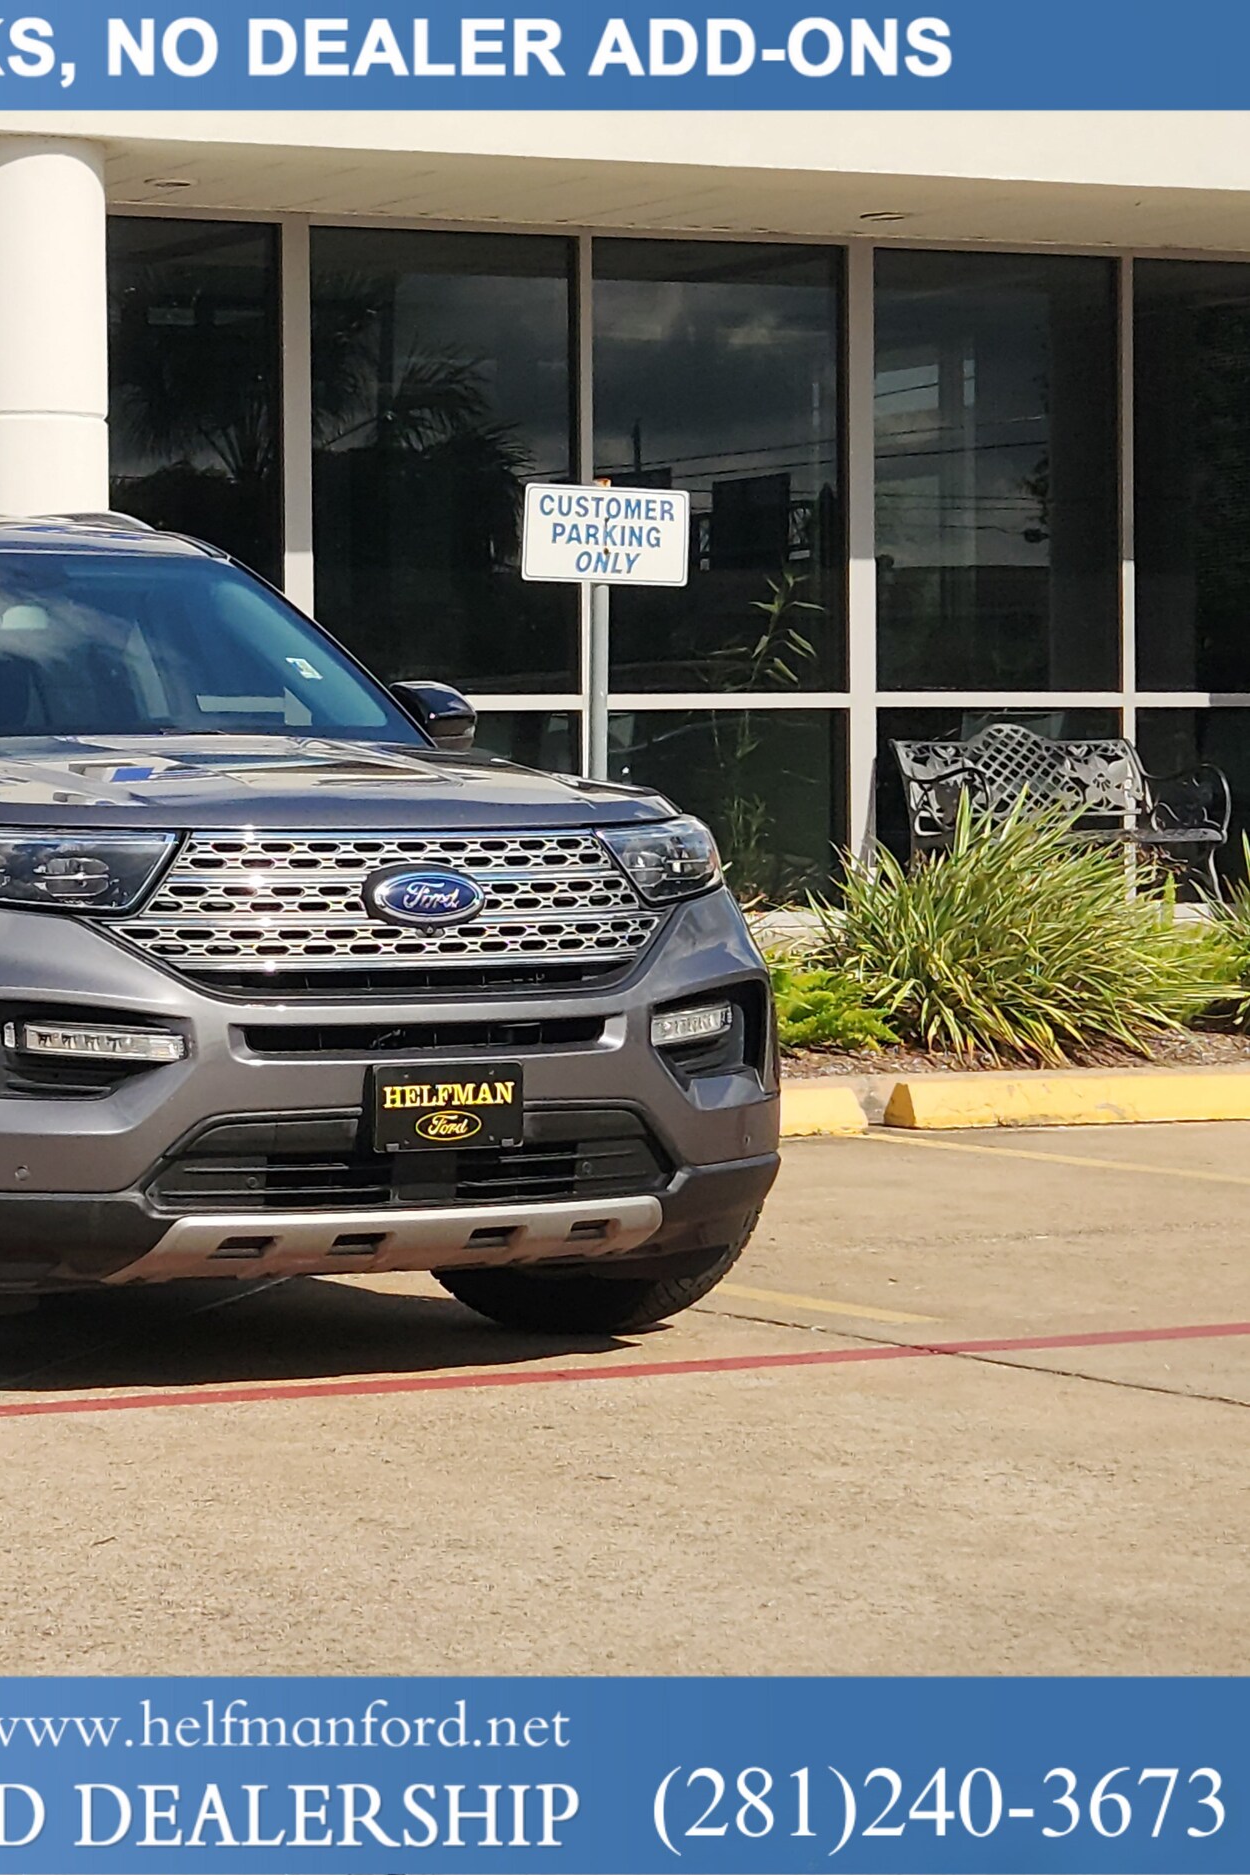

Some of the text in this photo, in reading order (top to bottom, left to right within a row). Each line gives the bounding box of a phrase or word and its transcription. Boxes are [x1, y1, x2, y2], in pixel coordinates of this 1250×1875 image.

[539, 494, 675, 522] CUSTOMER
[551, 522, 662, 548] PARKING
[575, 550, 641, 575] ONLY
[403, 881, 460, 909] Ford
[382, 1081, 516, 1109] HELFMAN
[427, 1114, 469, 1135] Ford
